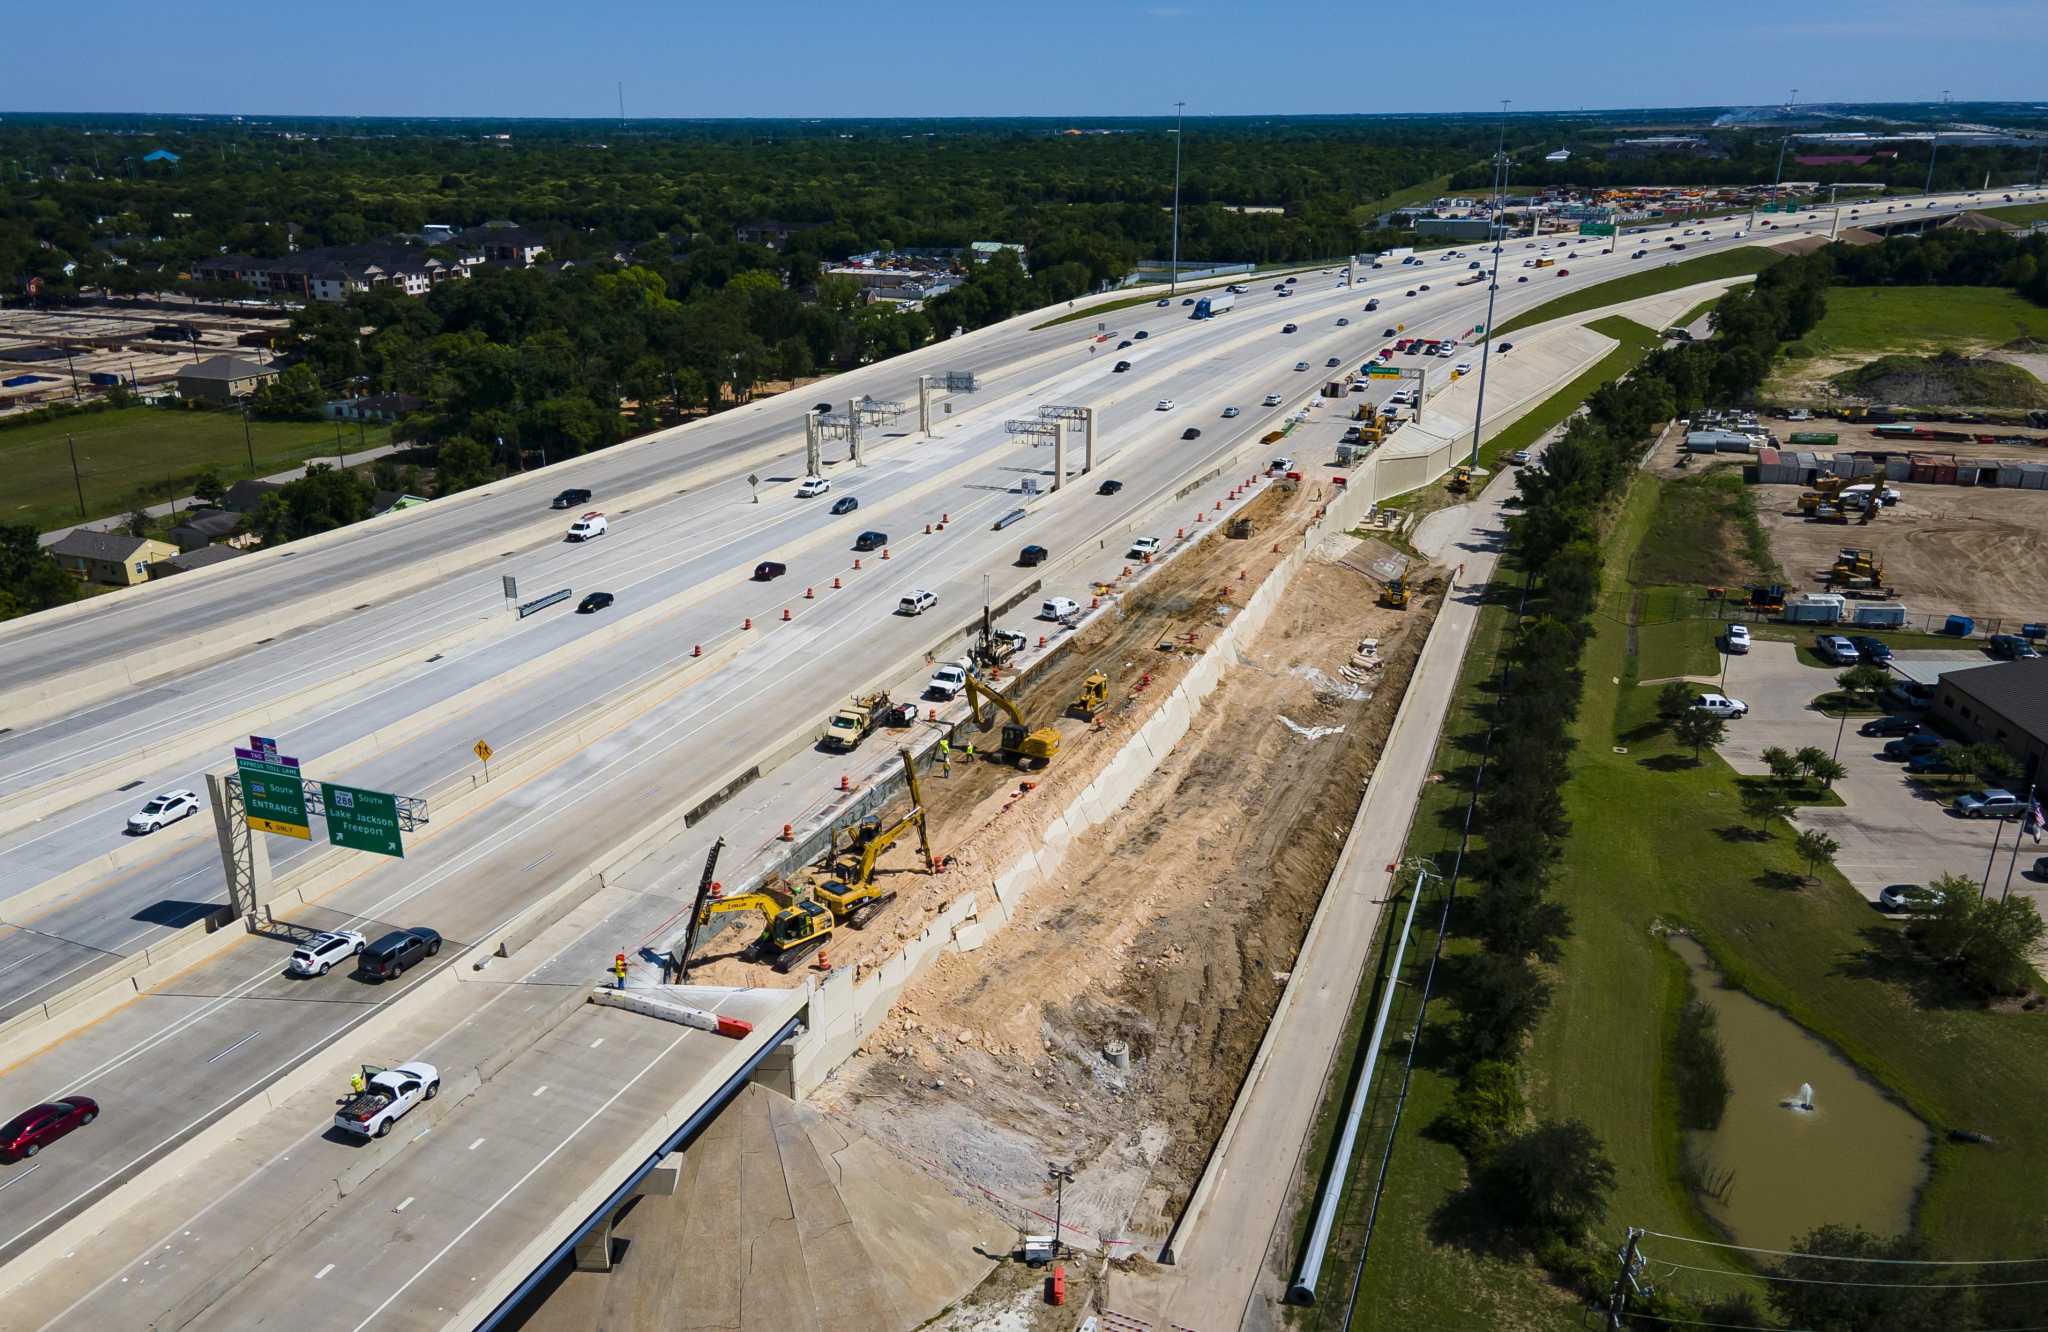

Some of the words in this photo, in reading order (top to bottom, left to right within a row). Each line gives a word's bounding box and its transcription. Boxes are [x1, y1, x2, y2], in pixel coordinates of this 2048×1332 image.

[265, 764, 280, 773] TOLL
[252, 799, 300, 815] ENTRANCE
[335, 795, 353, 807] 288
[329, 808, 352, 819] Lake
[357, 813, 394, 828] Jackson
[343, 821, 384, 836] Freeport
